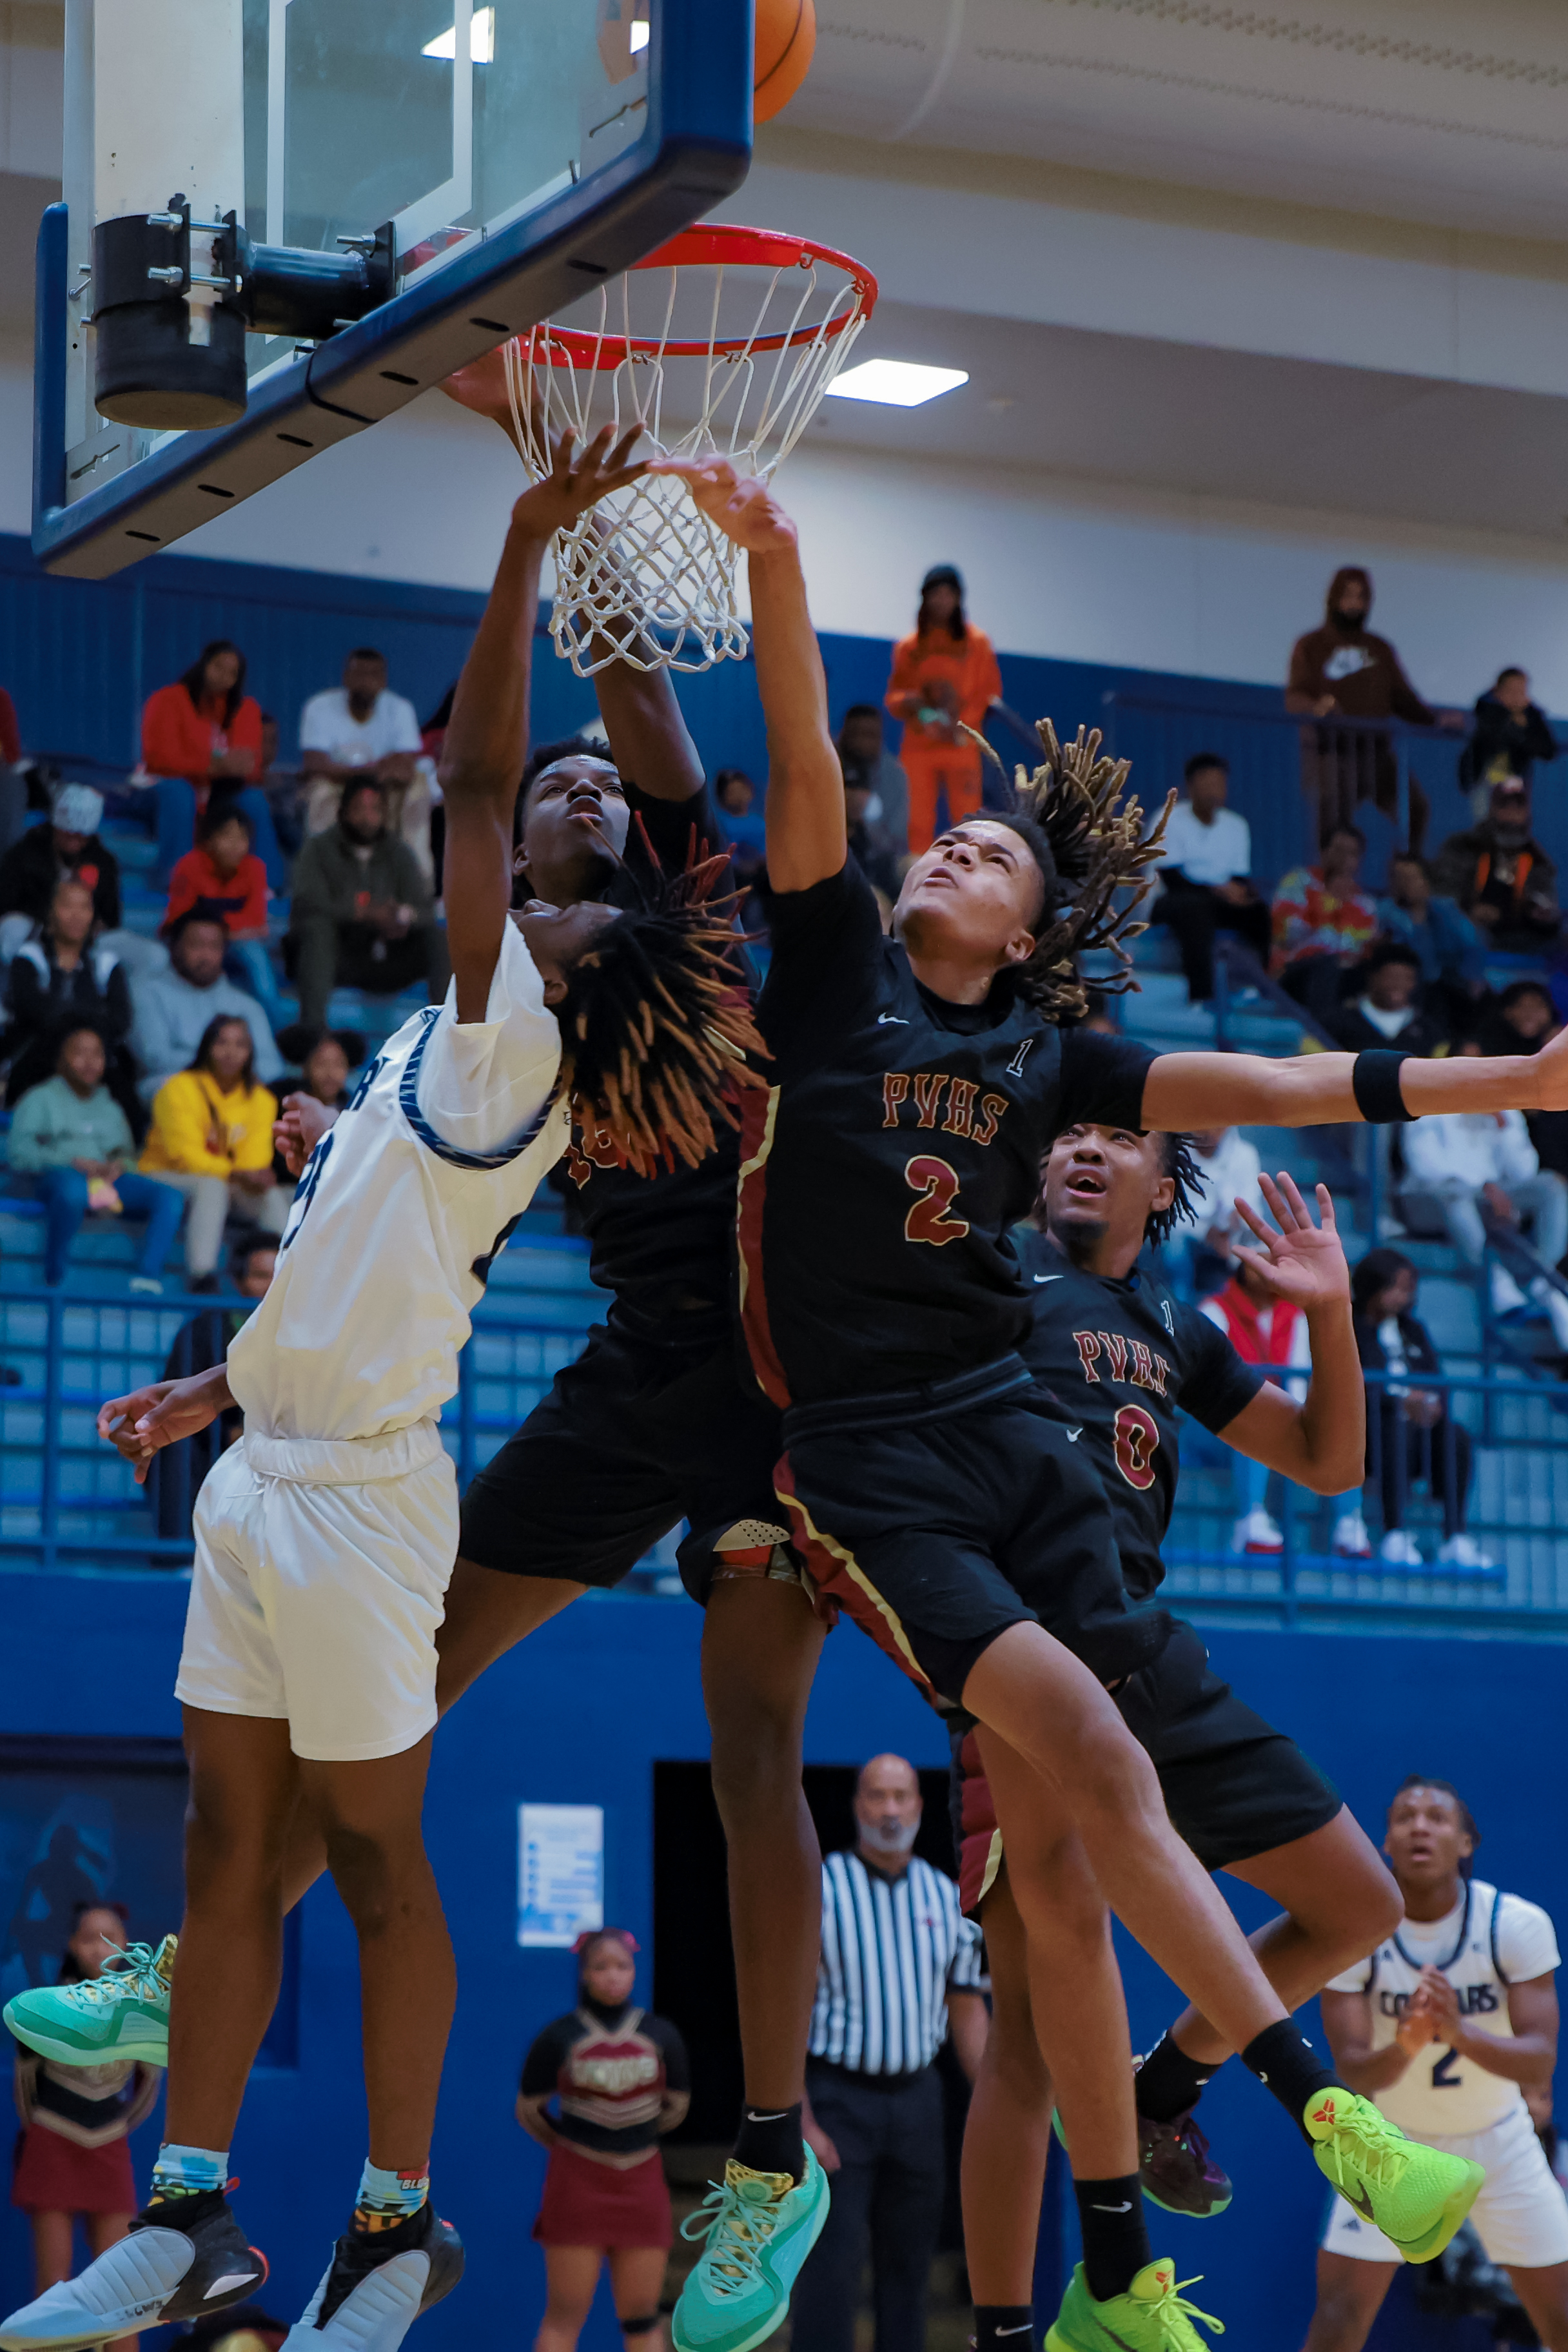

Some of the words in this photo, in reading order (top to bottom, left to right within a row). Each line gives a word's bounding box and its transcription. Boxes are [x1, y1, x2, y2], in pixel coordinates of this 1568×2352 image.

[1005, 1038, 1034, 1077] 1
[882, 1072, 1010, 1146] PVHS
[904, 1154, 970, 1246] 2
[1161, 1299, 1174, 1337] 1
[1073, 1329, 1171, 1398] PVHS
[1112, 1403, 1160, 1491] 0
[1433, 2035, 1462, 2088] 2
